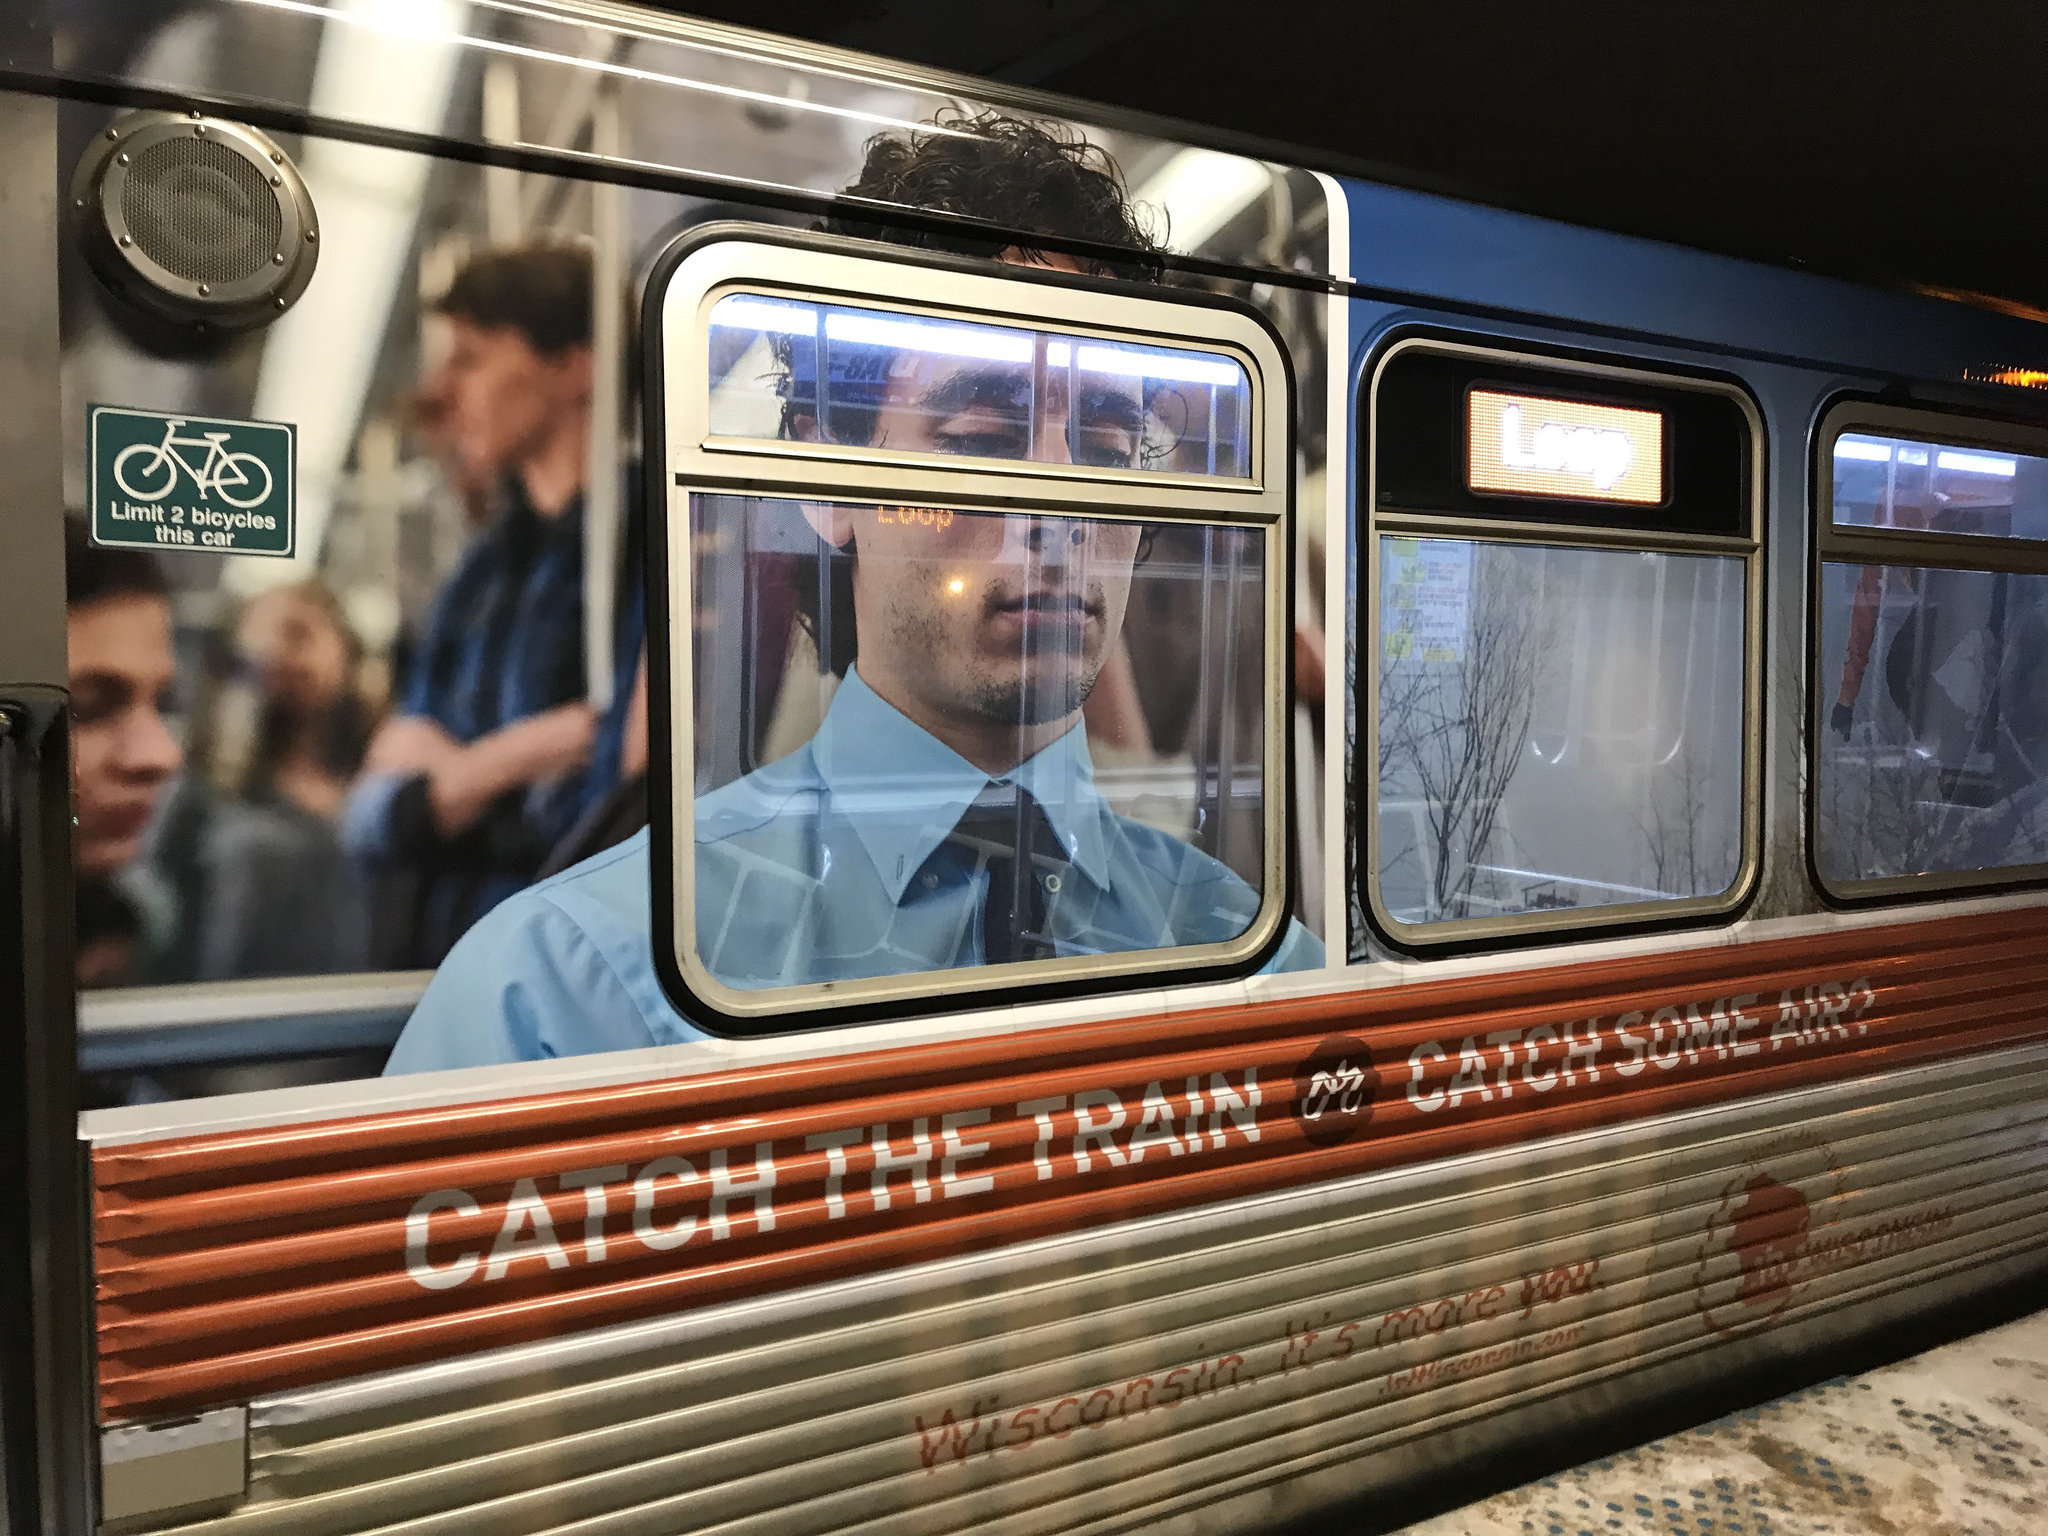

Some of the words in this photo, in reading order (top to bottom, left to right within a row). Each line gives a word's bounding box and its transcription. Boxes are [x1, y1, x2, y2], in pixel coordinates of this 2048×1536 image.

[111, 501, 165, 523] Limit
[170, 505, 185, 524] 2
[191, 506, 276, 531] bicycles
[154, 525, 195, 544] this
[201, 531, 235, 547] car
[404, 1141, 777, 1290] CATCH
[805, 1108, 995, 1220] THE
[1015, 1067, 1262, 1181] TRAIN
[1405, 1016, 1602, 1112] CATCH
[1613, 993, 1761, 1076] SOME
[1769, 977, 1876, 1052] AIR?
[914, 1342, 1255, 1475] Wisconsin.
[1280, 1311, 1360, 1375] It's
[1374, 1286, 1506, 1349] more
